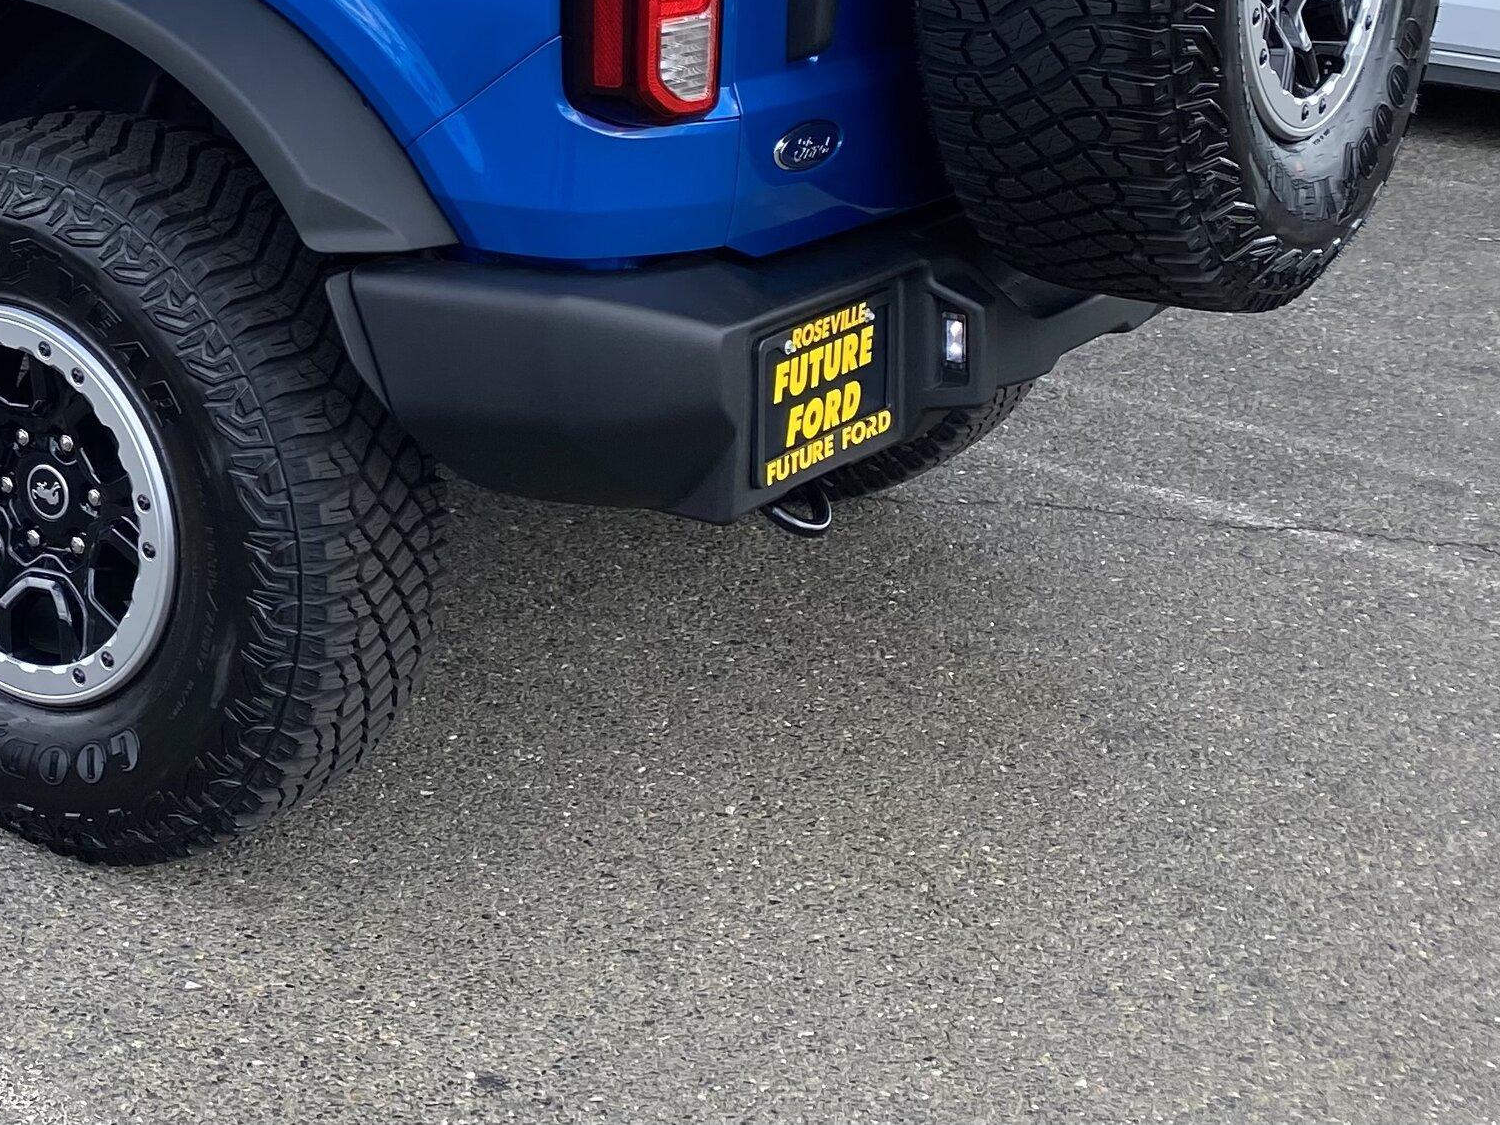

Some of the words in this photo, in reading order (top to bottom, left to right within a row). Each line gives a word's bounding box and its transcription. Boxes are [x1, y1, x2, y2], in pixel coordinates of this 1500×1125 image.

[791, 302, 867, 350] ROSEVILLE
[773, 325, 875, 405] FUTURE
[766, 433, 835, 487] FUTURE
[841, 409, 892, 451] FORD
[785, 380, 862, 448] FORD
